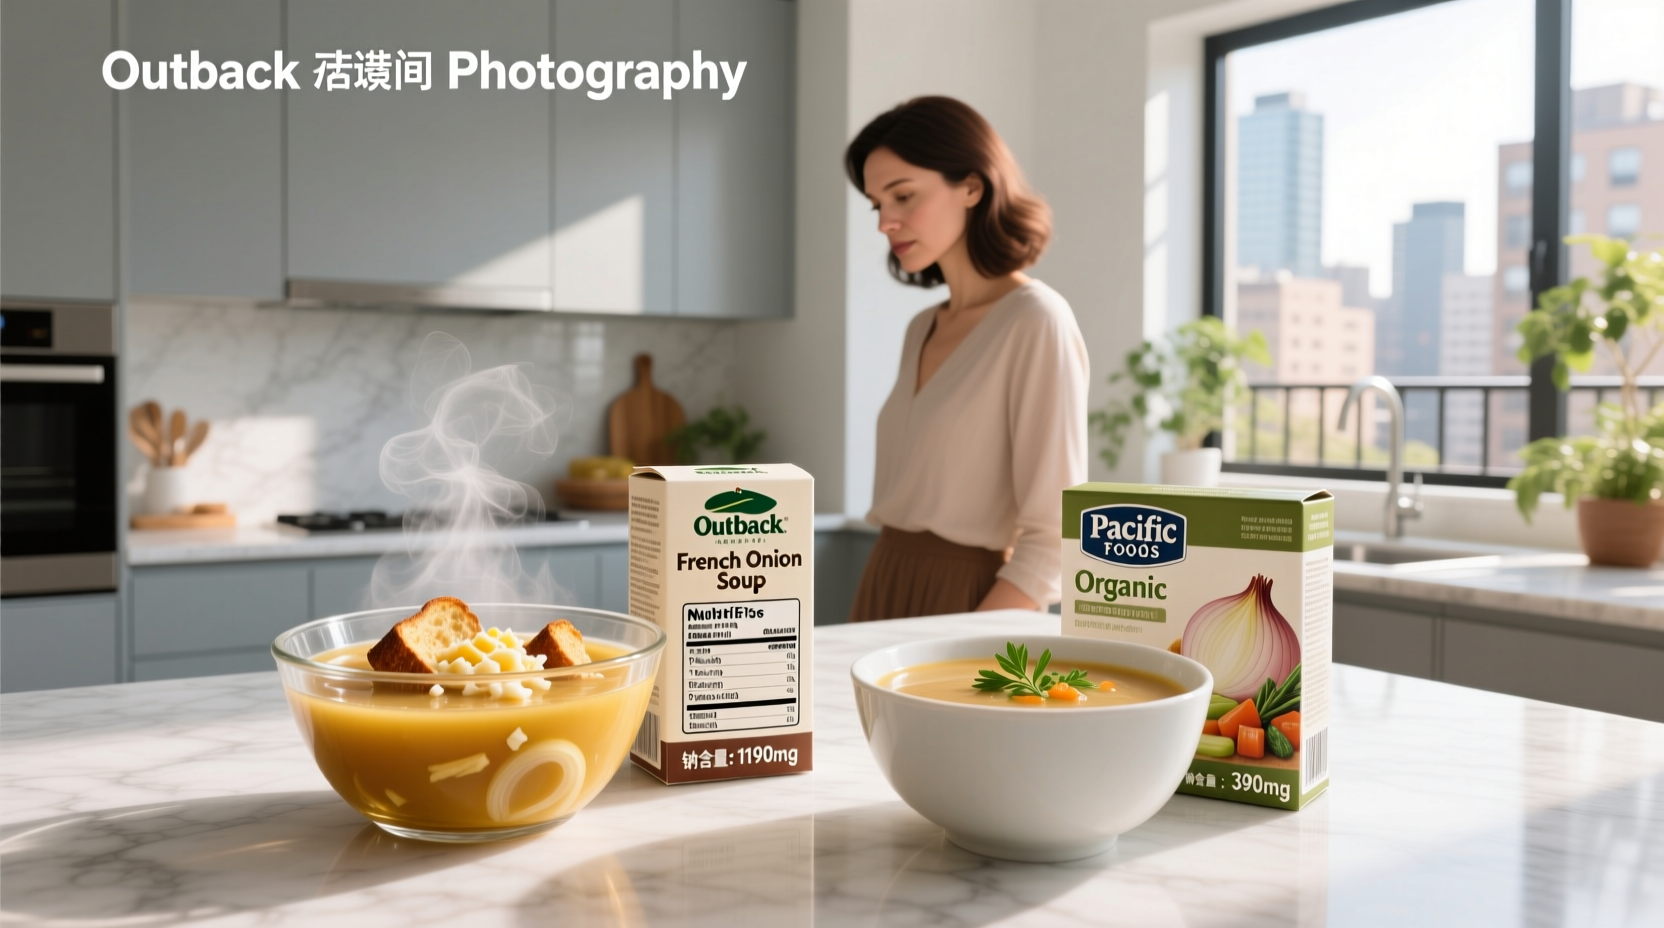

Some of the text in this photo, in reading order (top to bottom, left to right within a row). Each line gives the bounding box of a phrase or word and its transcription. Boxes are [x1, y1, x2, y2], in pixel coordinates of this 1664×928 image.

[693, 514, 784, 536] Outback
[1090, 514, 1177, 544] Pacific
[677, 549, 802, 571] French Onion
[716, 571, 766, 594] Soup
[1074, 569, 1167, 602] Organic
[737, 745, 798, 766] 1190mg
[1231, 772, 1291, 802] 390mg
